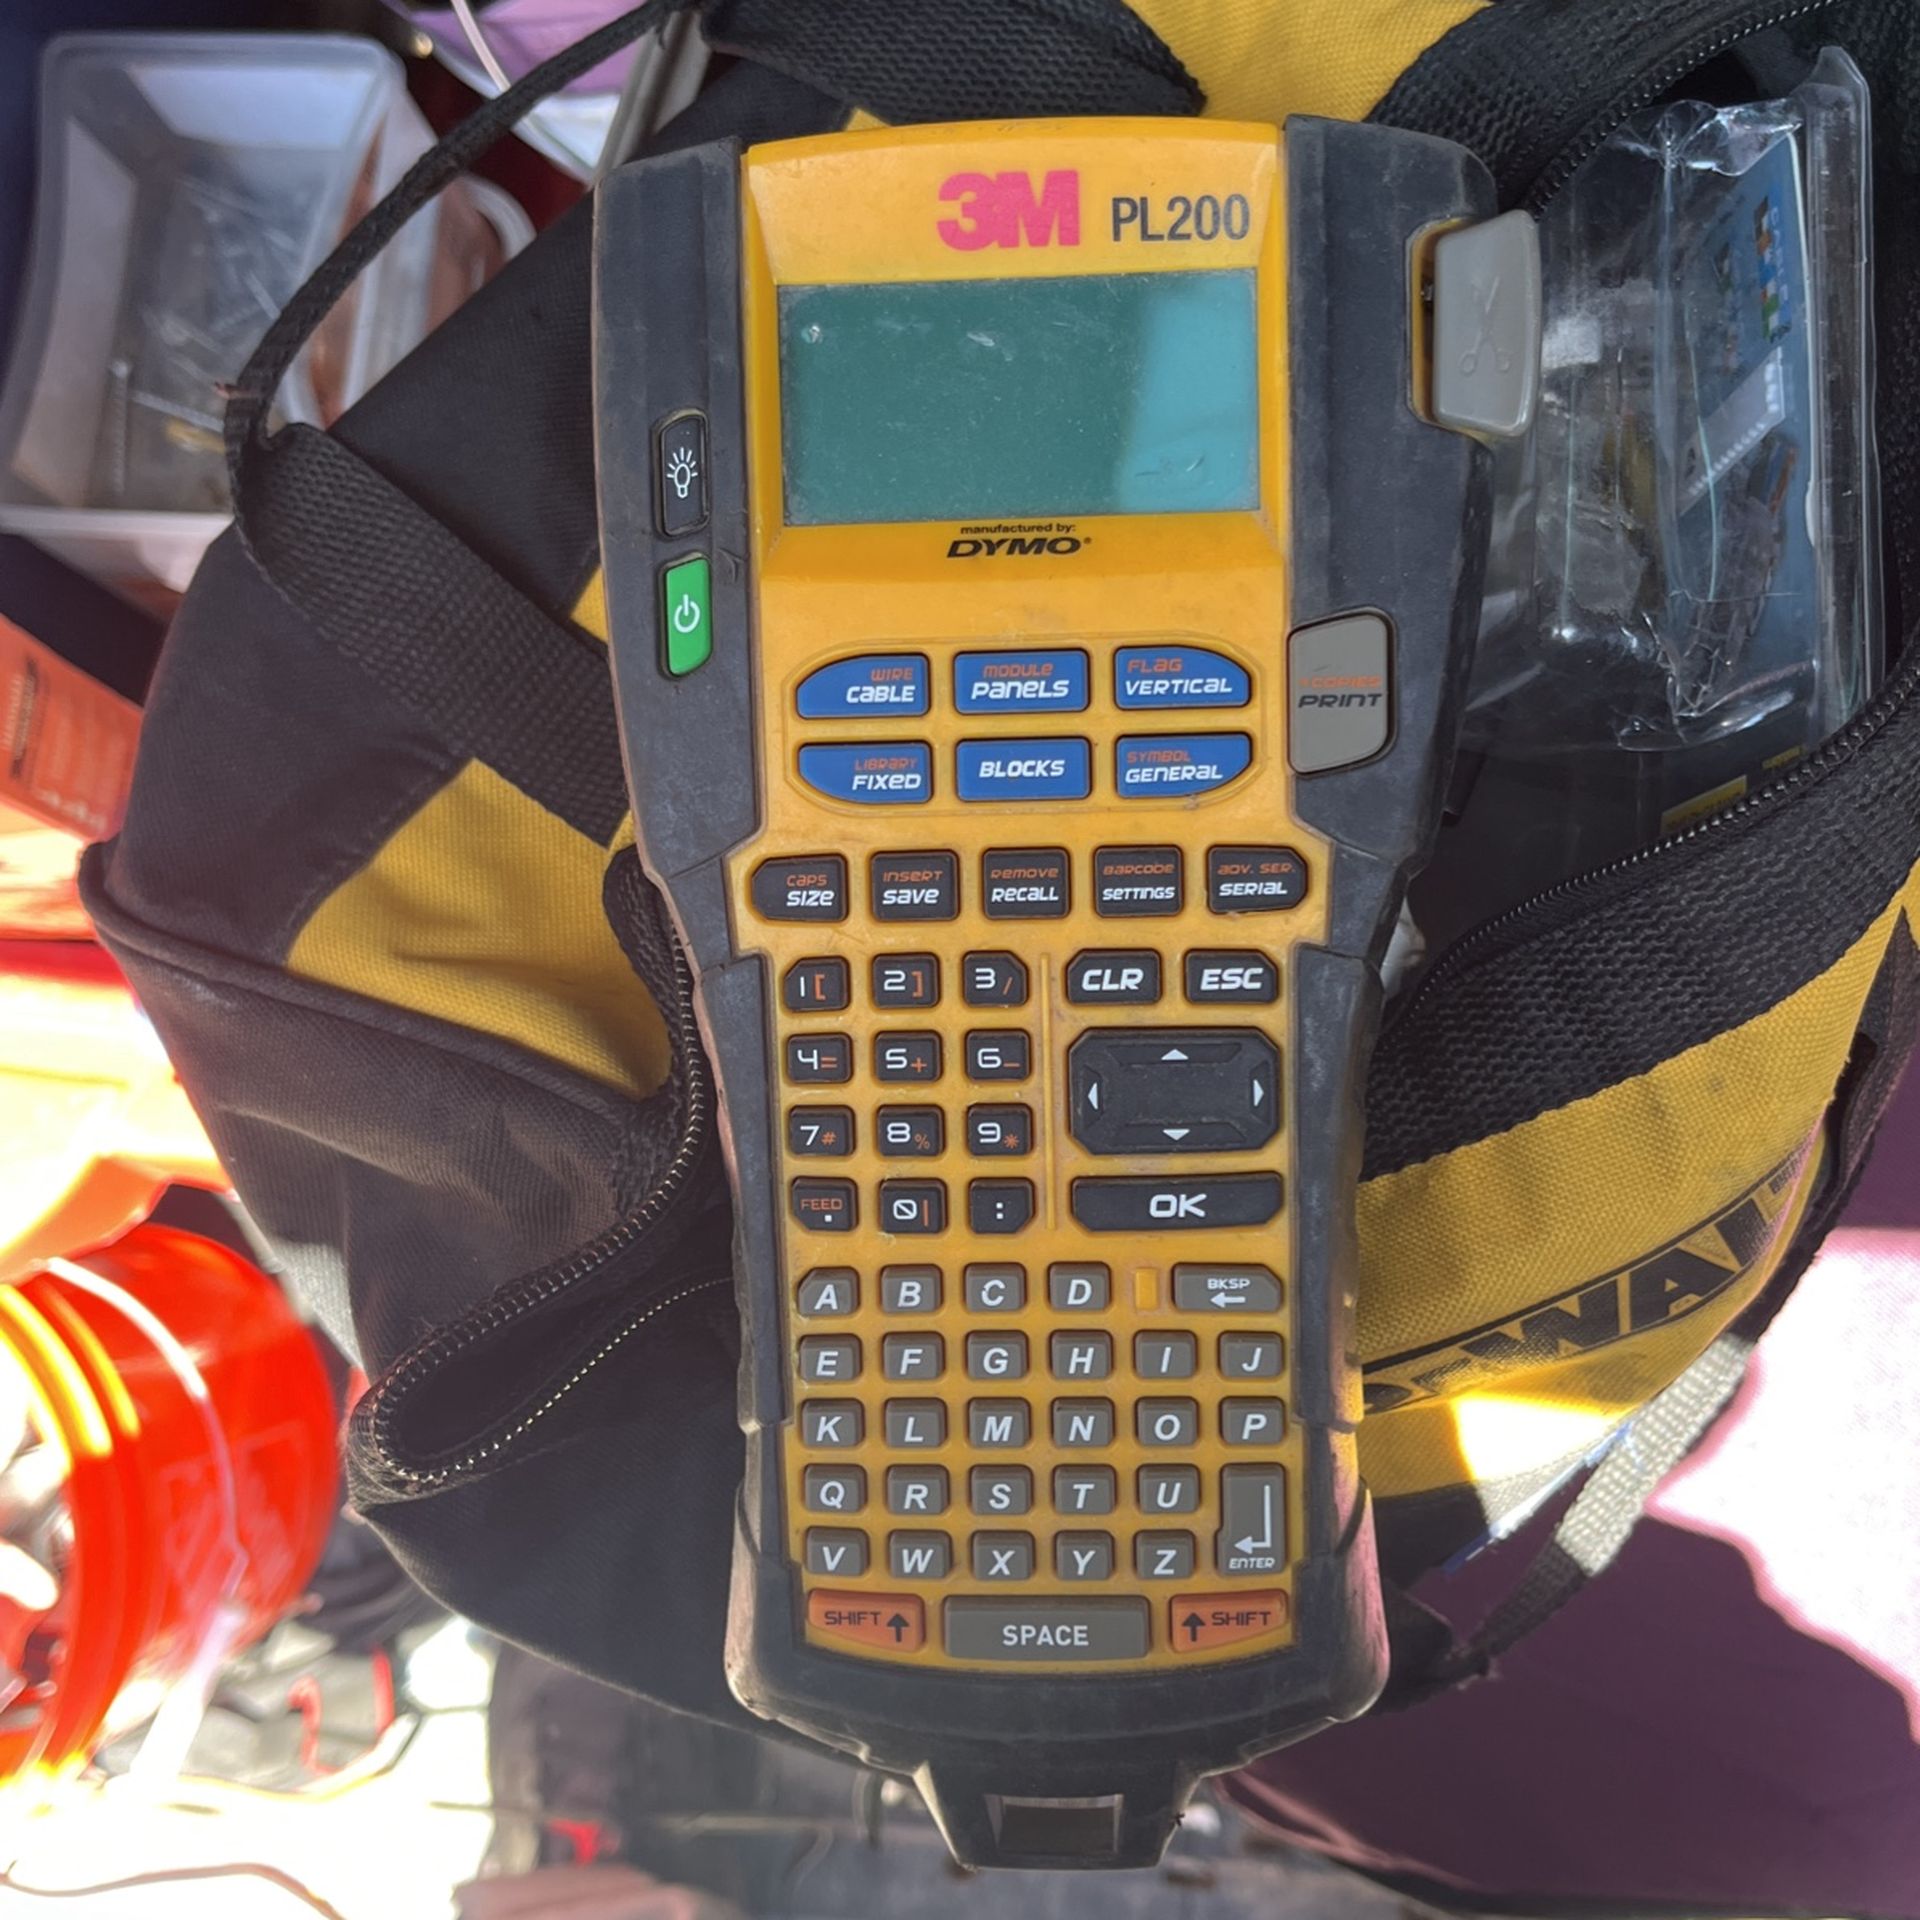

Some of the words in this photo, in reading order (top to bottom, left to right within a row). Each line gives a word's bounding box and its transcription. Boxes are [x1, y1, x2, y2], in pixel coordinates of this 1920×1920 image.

[937, 169, 1081, 251] 3M
[1110, 193, 1251, 242] PL200
[960, 523, 1052, 534] manufactured
[979, 758, 1066, 779] BLOCKS
[1082, 968, 1143, 990] CLR
[1201, 968, 1263, 990] ESC
[801, 1198, 842, 1210] FEED
[1150, 1194, 1206, 1217] OK
[898, 1282, 921, 1306] B
[982, 1280, 1005, 1306] C
[1068, 1279, 1091, 1304] D
[1208, 1278, 1250, 1289] BKSP
[815, 1284, 837, 1309] A
[817, 1351, 838, 1376] E
[900, 1349, 922, 1374] F
[984, 1348, 1008, 1374] G
[1069, 1348, 1094, 1374] H
[1161, 1347, 1171, 1372] I
[1242, 1348, 1261, 1371] J
[817, 1416, 841, 1442] K
[905, 1417, 923, 1442] L
[983, 1416, 1012, 1441] M
[1069, 1416, 1094, 1441] N
[1155, 1415, 1180, 1440] O
[1243, 1414, 1266, 1439] P
[820, 1481, 844, 1509] Q
[904, 1484, 928, 1509] R
[989, 1484, 1011, 1509] S
[1073, 1484, 1094, 1508] T
[1158, 1483, 1181, 1508] U
[823, 1547, 845, 1570] V
[903, 1549, 933, 1573] W
[989, 1550, 1014, 1575] X
[1073, 1551, 1095, 1575] Y
[1154, 1550, 1176, 1574] Z
[1229, 1557, 1275, 1569] ENTER
[824, 1611, 881, 1625] SHIFT
[1211, 1611, 1271, 1626] SHIFT
[1003, 1625, 1088, 1645] SPACE
